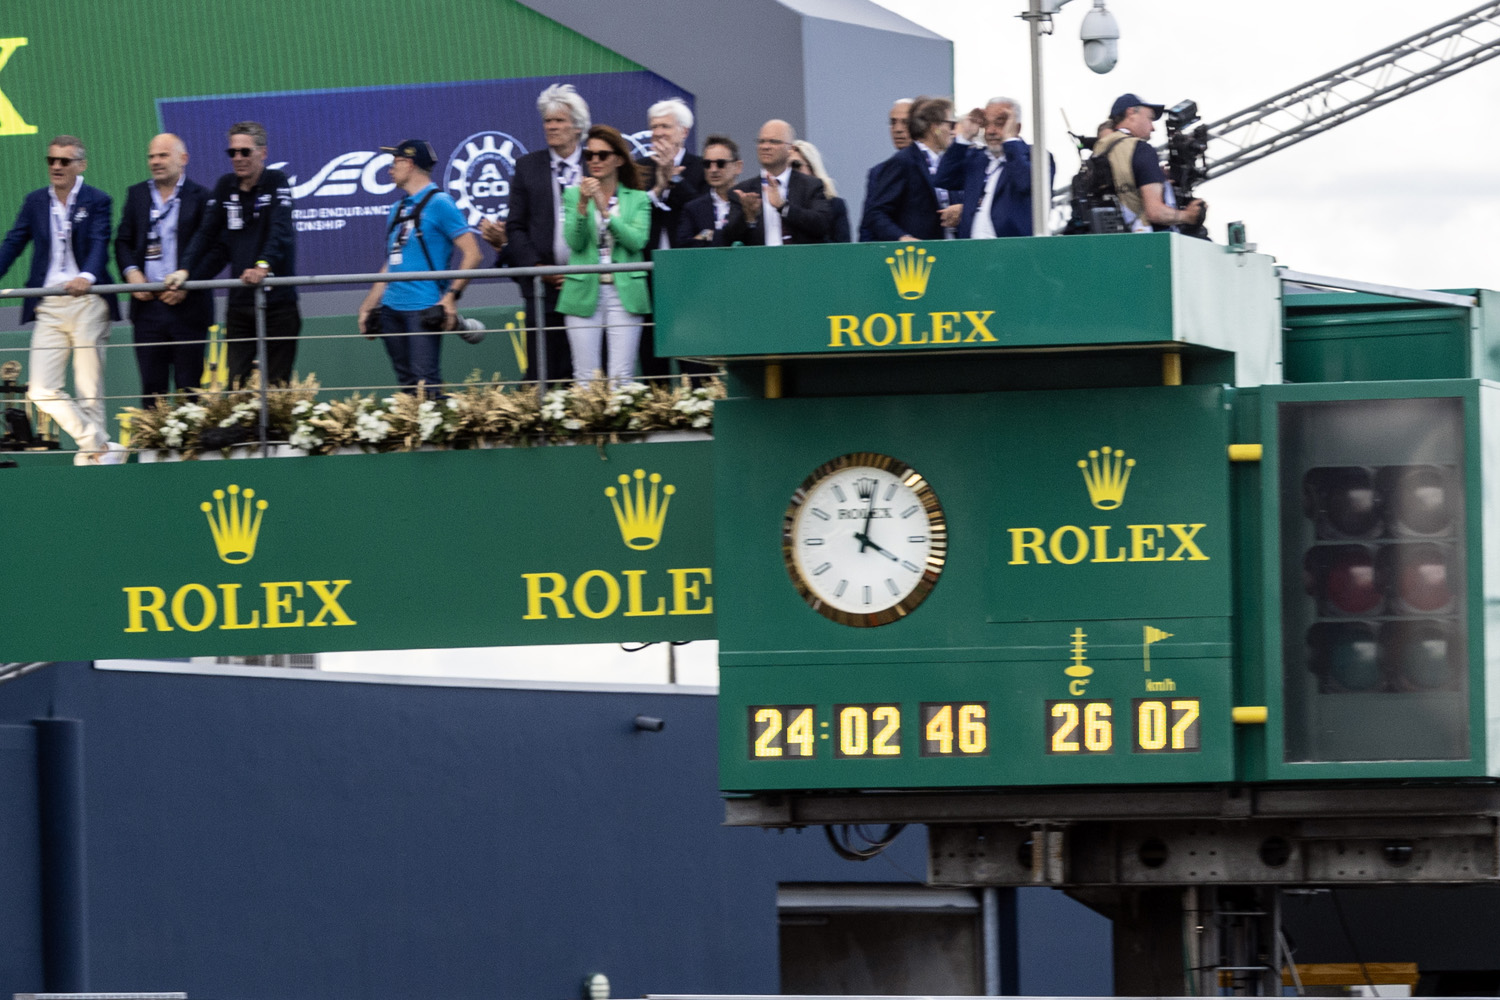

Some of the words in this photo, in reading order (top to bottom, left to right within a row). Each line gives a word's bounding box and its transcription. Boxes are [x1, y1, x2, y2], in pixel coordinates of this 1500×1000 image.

[828, 311, 998, 347] ROLEX
[1007, 523, 1210, 565] ROLEX
[122, 579, 357, 633] ROLEX
[521, 567, 713, 620] ROLE
[926, 704, 987, 754] 46
[1051, 702, 1112, 752] 26
[1138, 700, 1200, 750] 07
